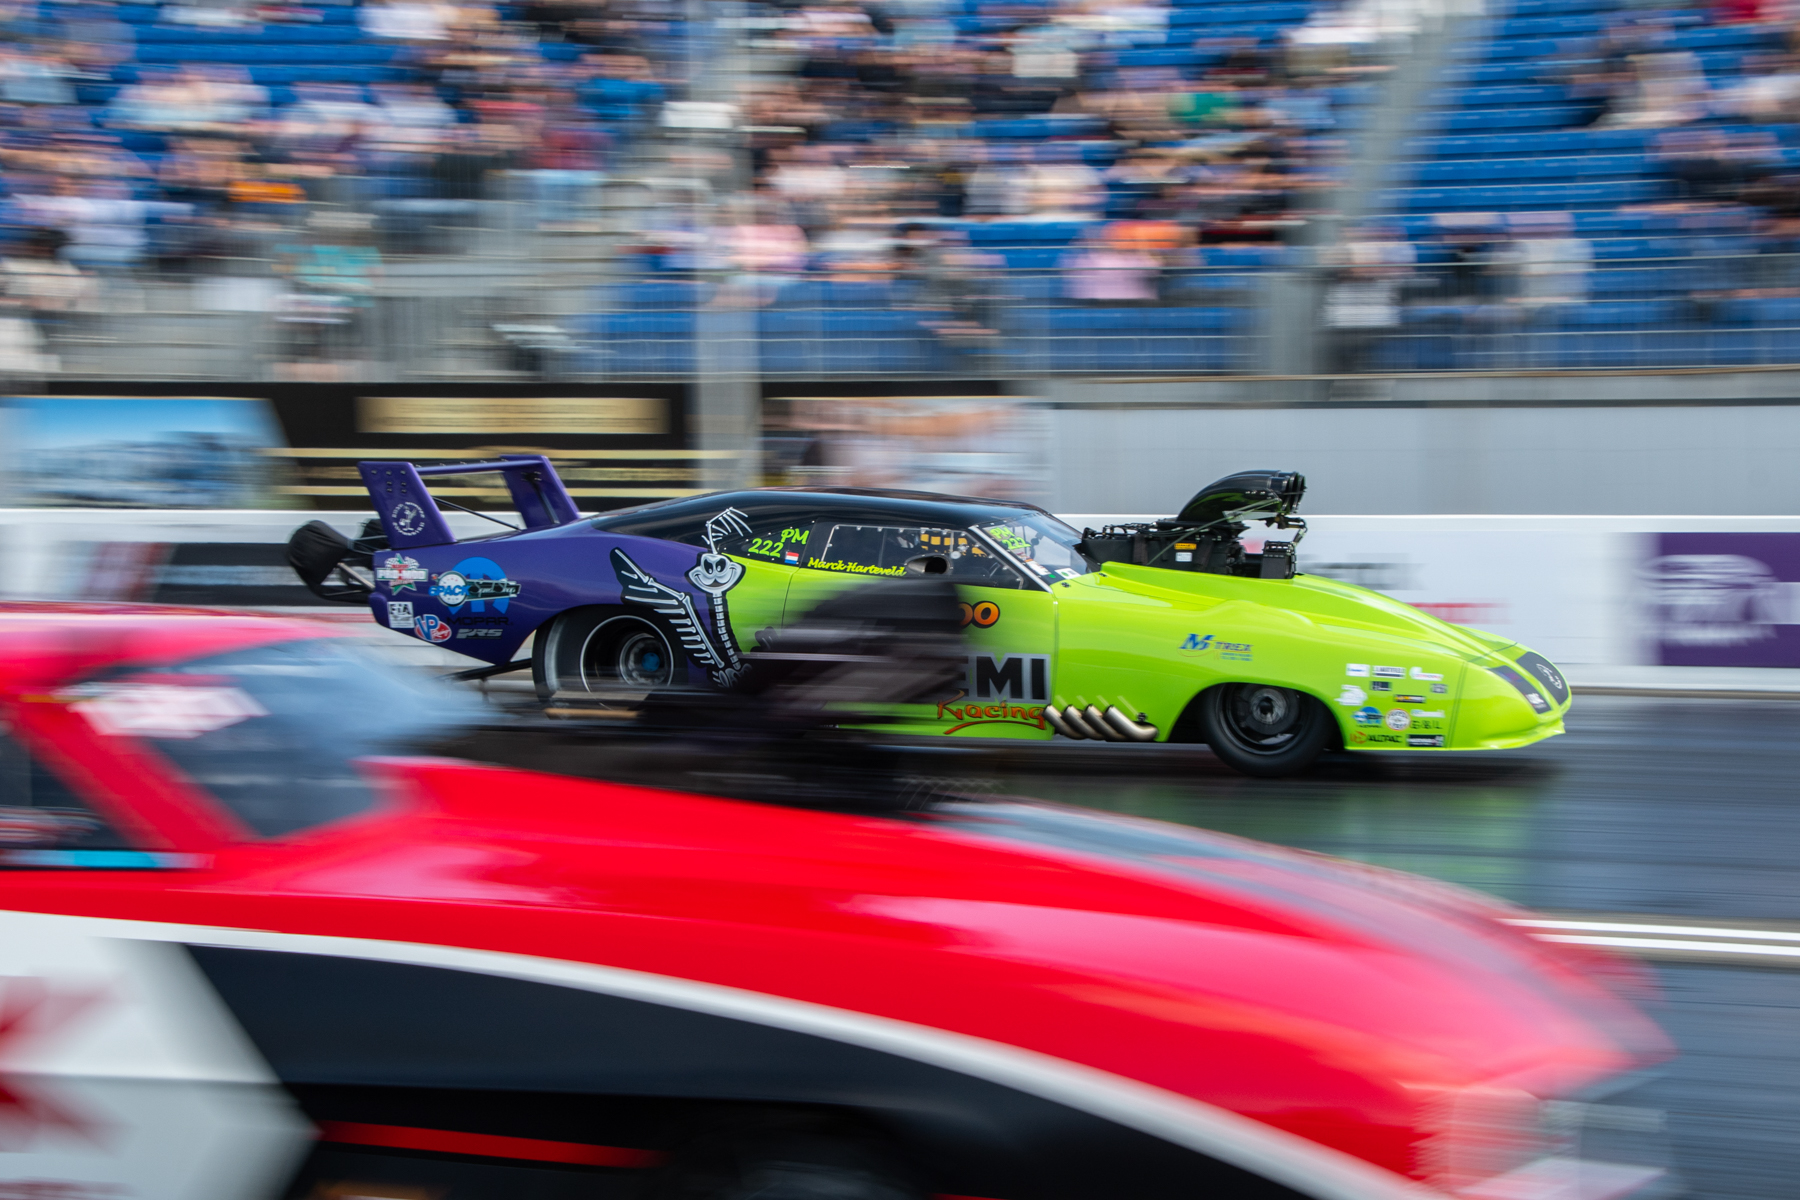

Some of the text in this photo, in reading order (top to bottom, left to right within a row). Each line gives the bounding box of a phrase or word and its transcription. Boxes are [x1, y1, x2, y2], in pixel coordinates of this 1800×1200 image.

[781, 528, 809, 545] PM
[1001, 536, 1032, 550] 222
[748, 538, 783, 558] 222
[807, 556, 907, 577] Marck Harteveld
[428, 585, 471, 597] 6PACK
[414, 613, 440, 642] VP
[446, 616, 510, 627] MOPAR
[937, 688, 1047, 731] Racing
